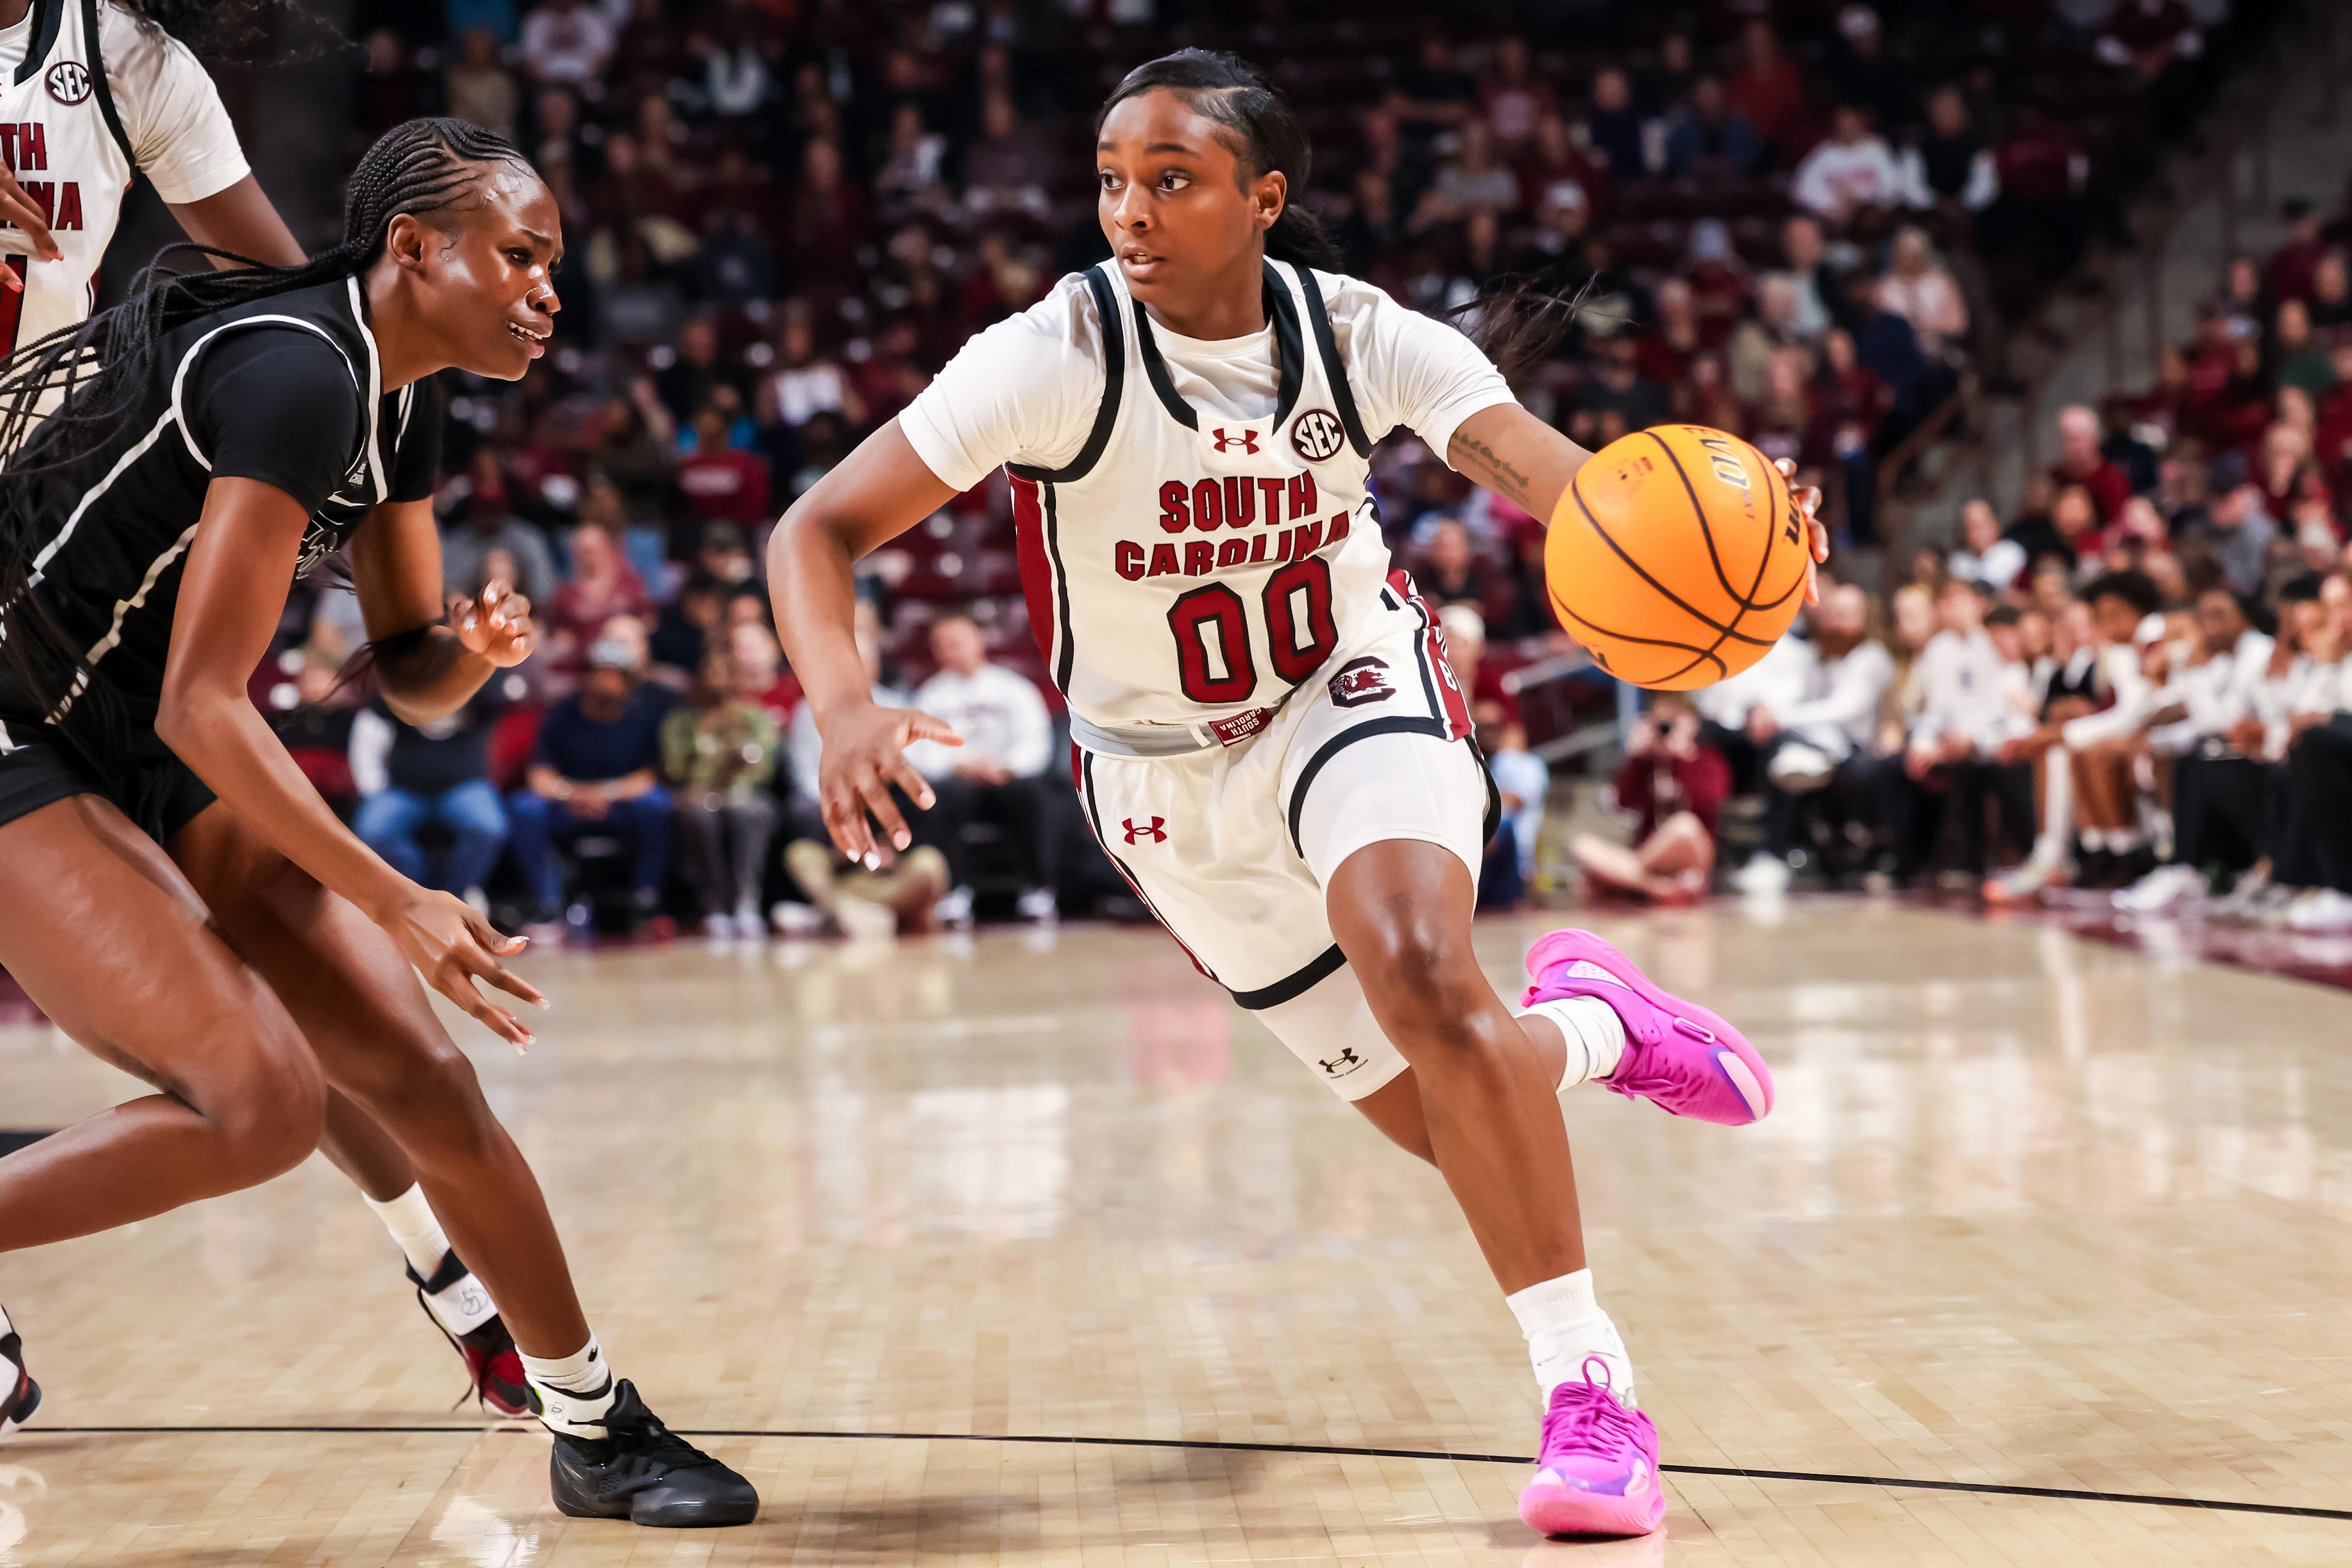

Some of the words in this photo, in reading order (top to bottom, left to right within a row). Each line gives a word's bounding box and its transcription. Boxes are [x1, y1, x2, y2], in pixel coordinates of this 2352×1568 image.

[49, 63, 89, 102] SEC
[1295, 412, 1341, 459] SEC
[1159, 469, 1317, 533] SOUTH
[1115, 510, 1349, 582] CAROLINA
[1167, 555, 1339, 703] 00
[1219, 707, 1262, 731] CAROLINA
[1230, 717, 1259, 736] SOUTH
